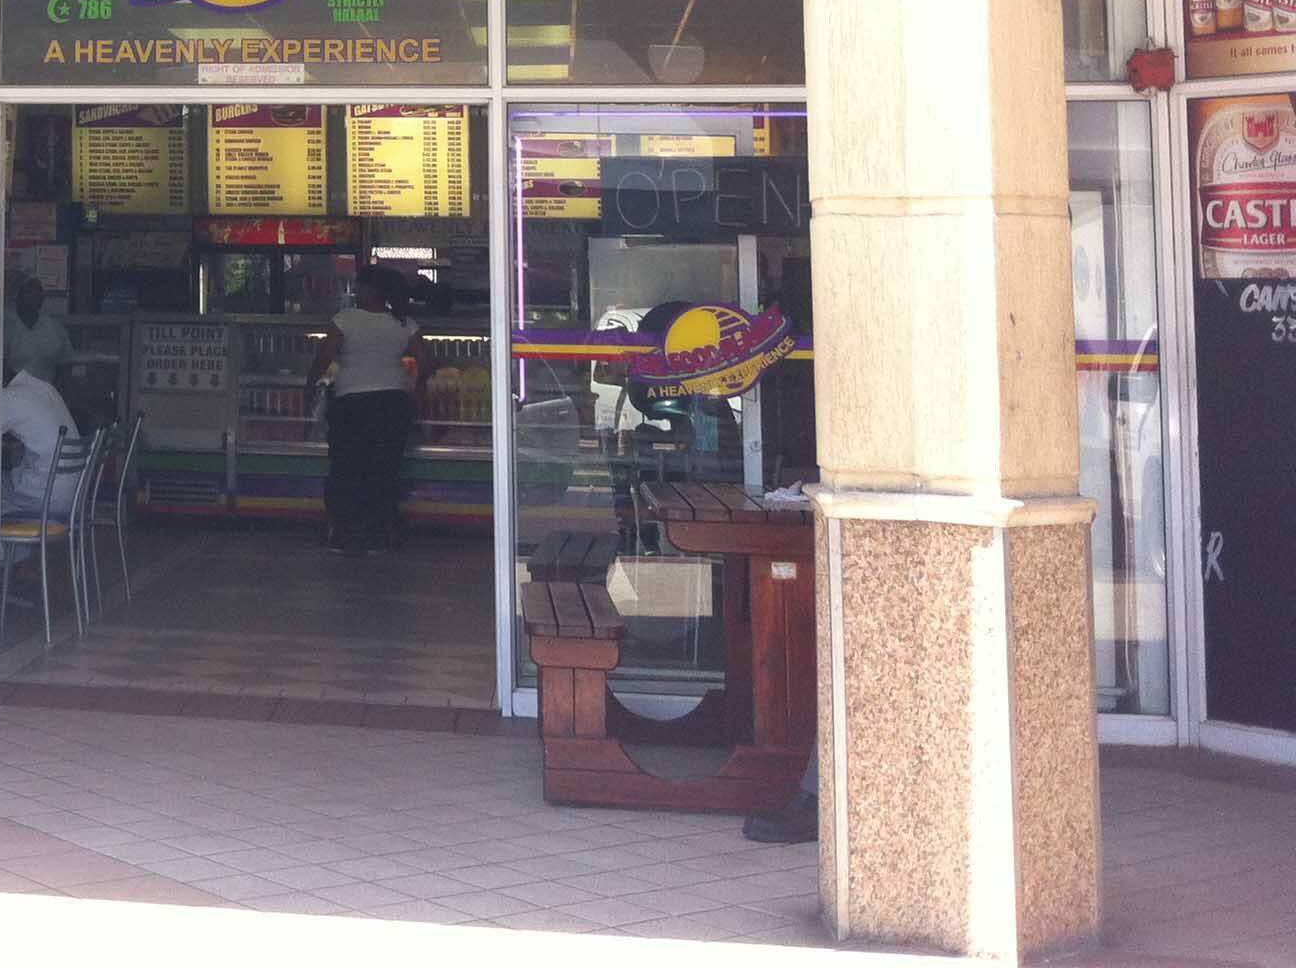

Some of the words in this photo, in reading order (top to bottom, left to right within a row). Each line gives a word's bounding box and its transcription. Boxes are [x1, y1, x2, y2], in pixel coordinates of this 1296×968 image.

[78, 0, 112, 21] 786
[43, 42, 65, 64] A
[74, 39, 235, 64] HEAVENLY
[241, 38, 441, 63] EXPERIENCE
[1241, 46, 1253, 57] all
[1256, 44, 1288, 56] comes
[616, 167, 801, 229] OPEN
[1243, 233, 1286, 246] LAGER
[1205, 531, 1225, 582] R
